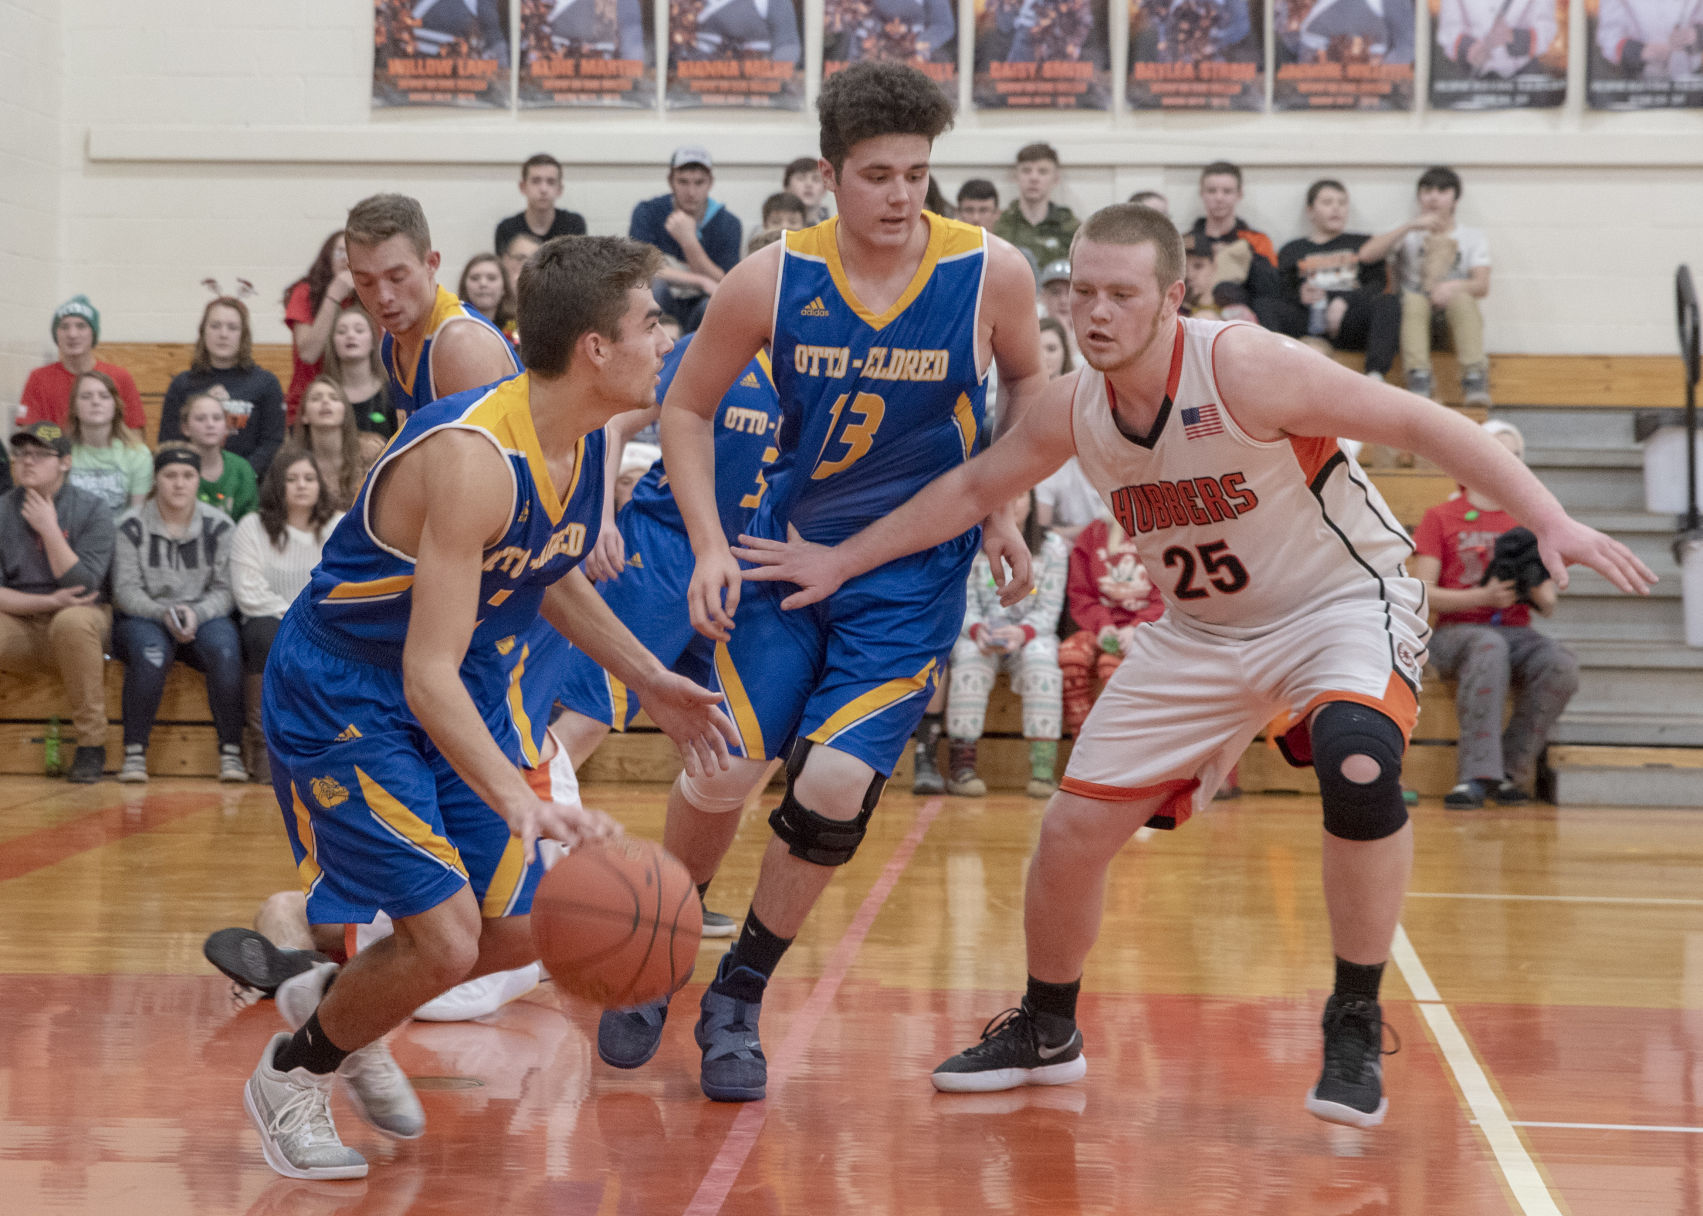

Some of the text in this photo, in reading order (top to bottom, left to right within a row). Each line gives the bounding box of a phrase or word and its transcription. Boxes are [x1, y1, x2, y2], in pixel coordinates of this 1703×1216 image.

[801, 309, 830, 317] adidas
[811, 391, 885, 480] 13
[1110, 471, 1259, 537] HUBBERS
[1162, 538, 1250, 600] 25
